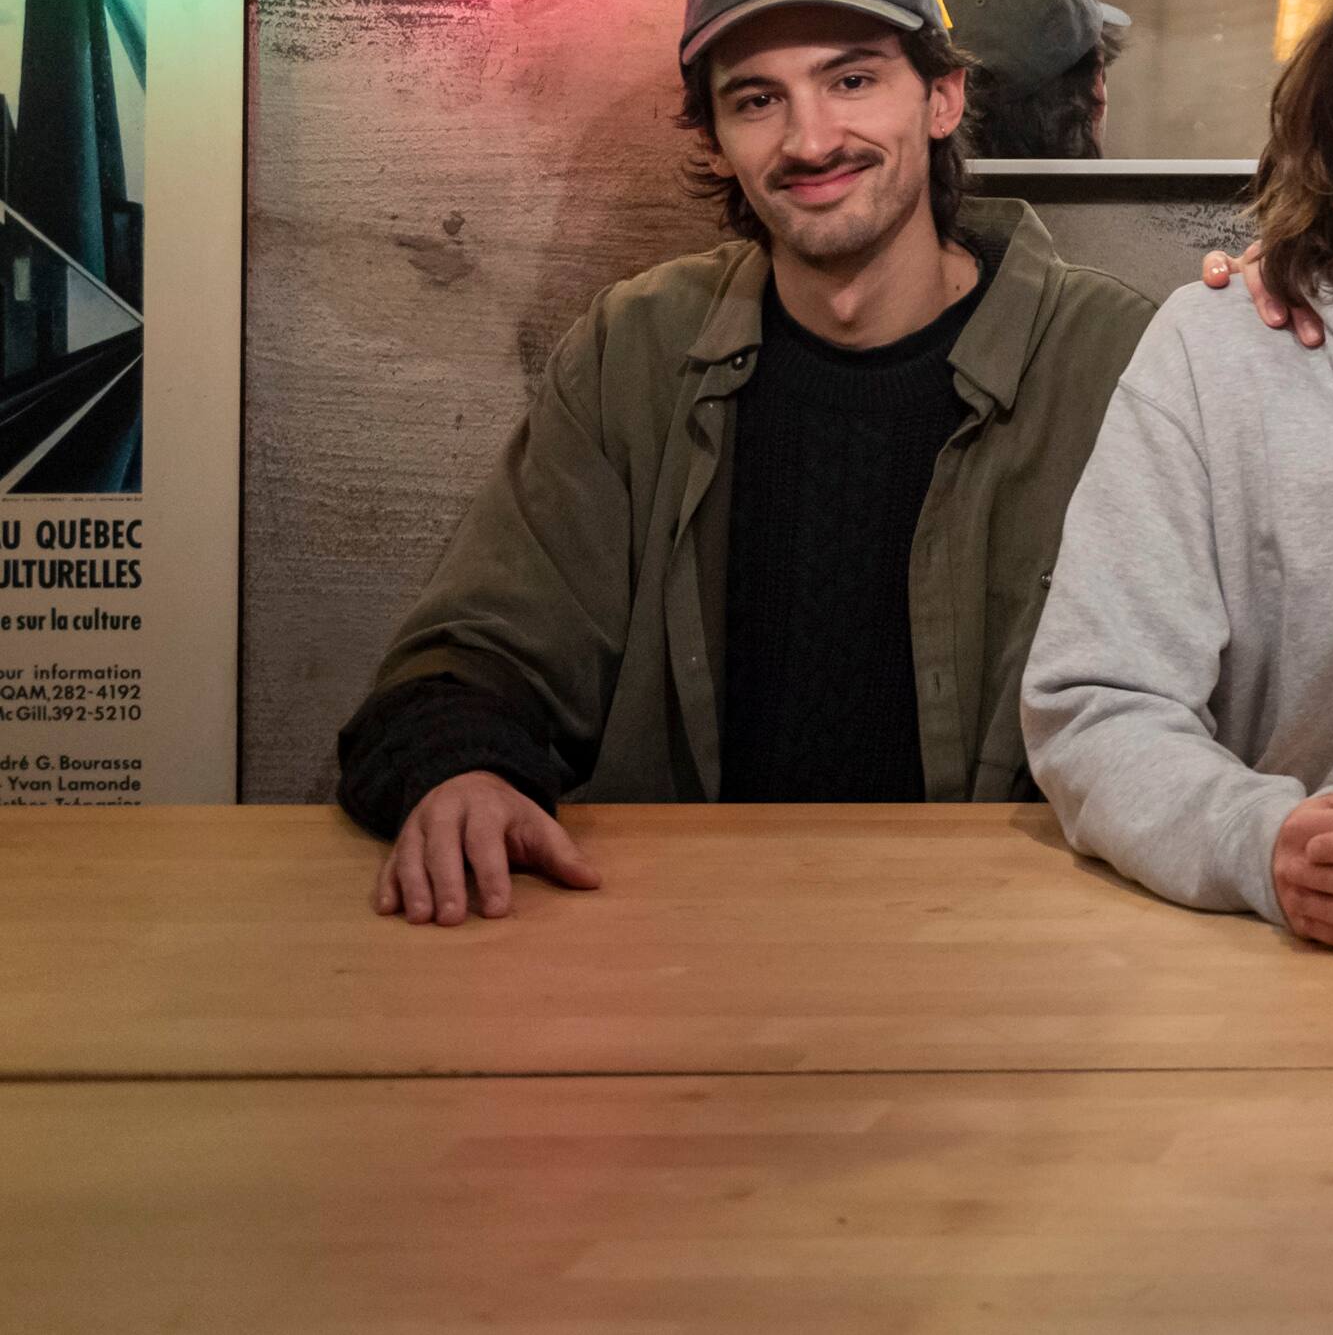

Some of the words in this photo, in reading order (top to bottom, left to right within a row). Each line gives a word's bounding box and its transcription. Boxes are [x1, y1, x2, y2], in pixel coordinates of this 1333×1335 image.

[17, 615, 46, 631] sur
[51, 607, 68, 631] la
[73, 607, 142, 631] culture
[34, 663, 141, 680] information
[36, 755, 55, 771] G.
[60, 755, 142, 771] Bourassa
[8, 775, 52, 791] Yvan
[58, 775, 141, 791] Lamonde
